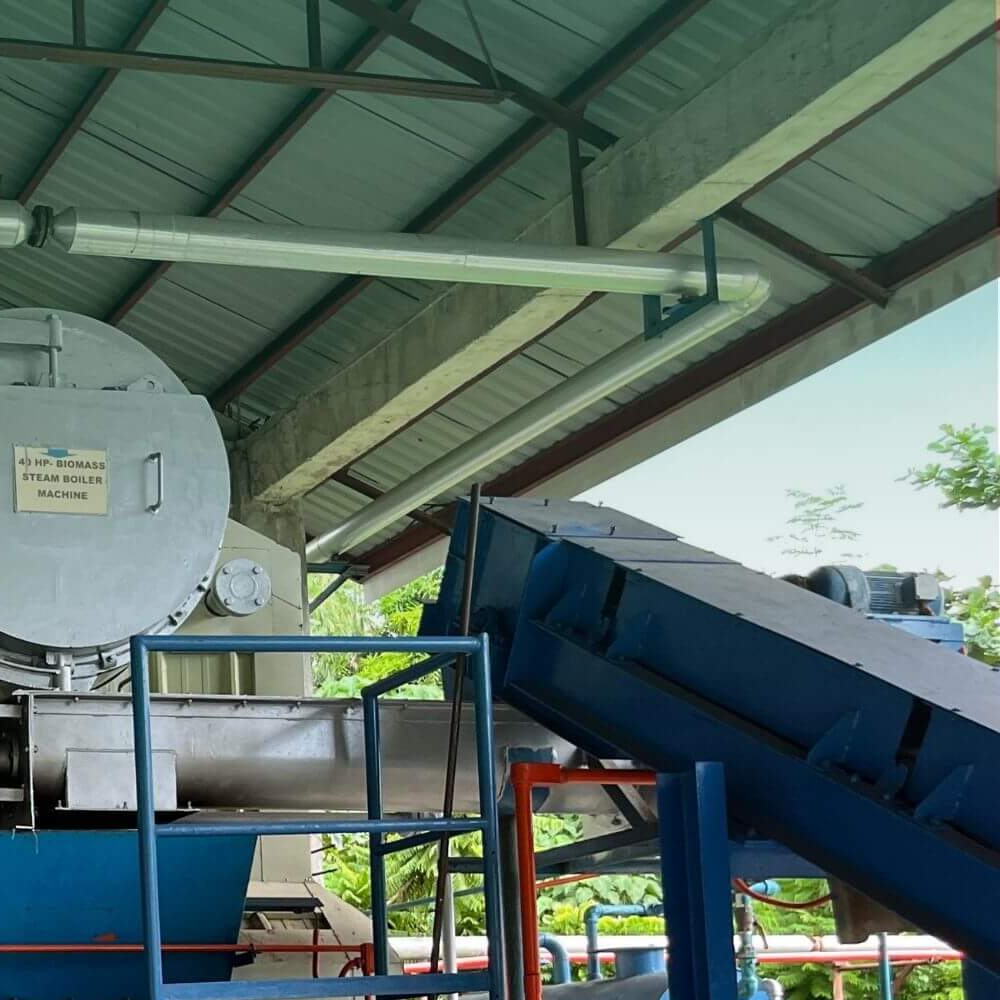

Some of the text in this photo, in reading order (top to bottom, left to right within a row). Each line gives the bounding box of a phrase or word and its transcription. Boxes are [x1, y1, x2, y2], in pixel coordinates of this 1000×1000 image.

[56, 459, 105, 470] BIOMASS
[22, 472, 103, 485] STEAM BOILER
[37, 489, 89, 501] MACHINE
